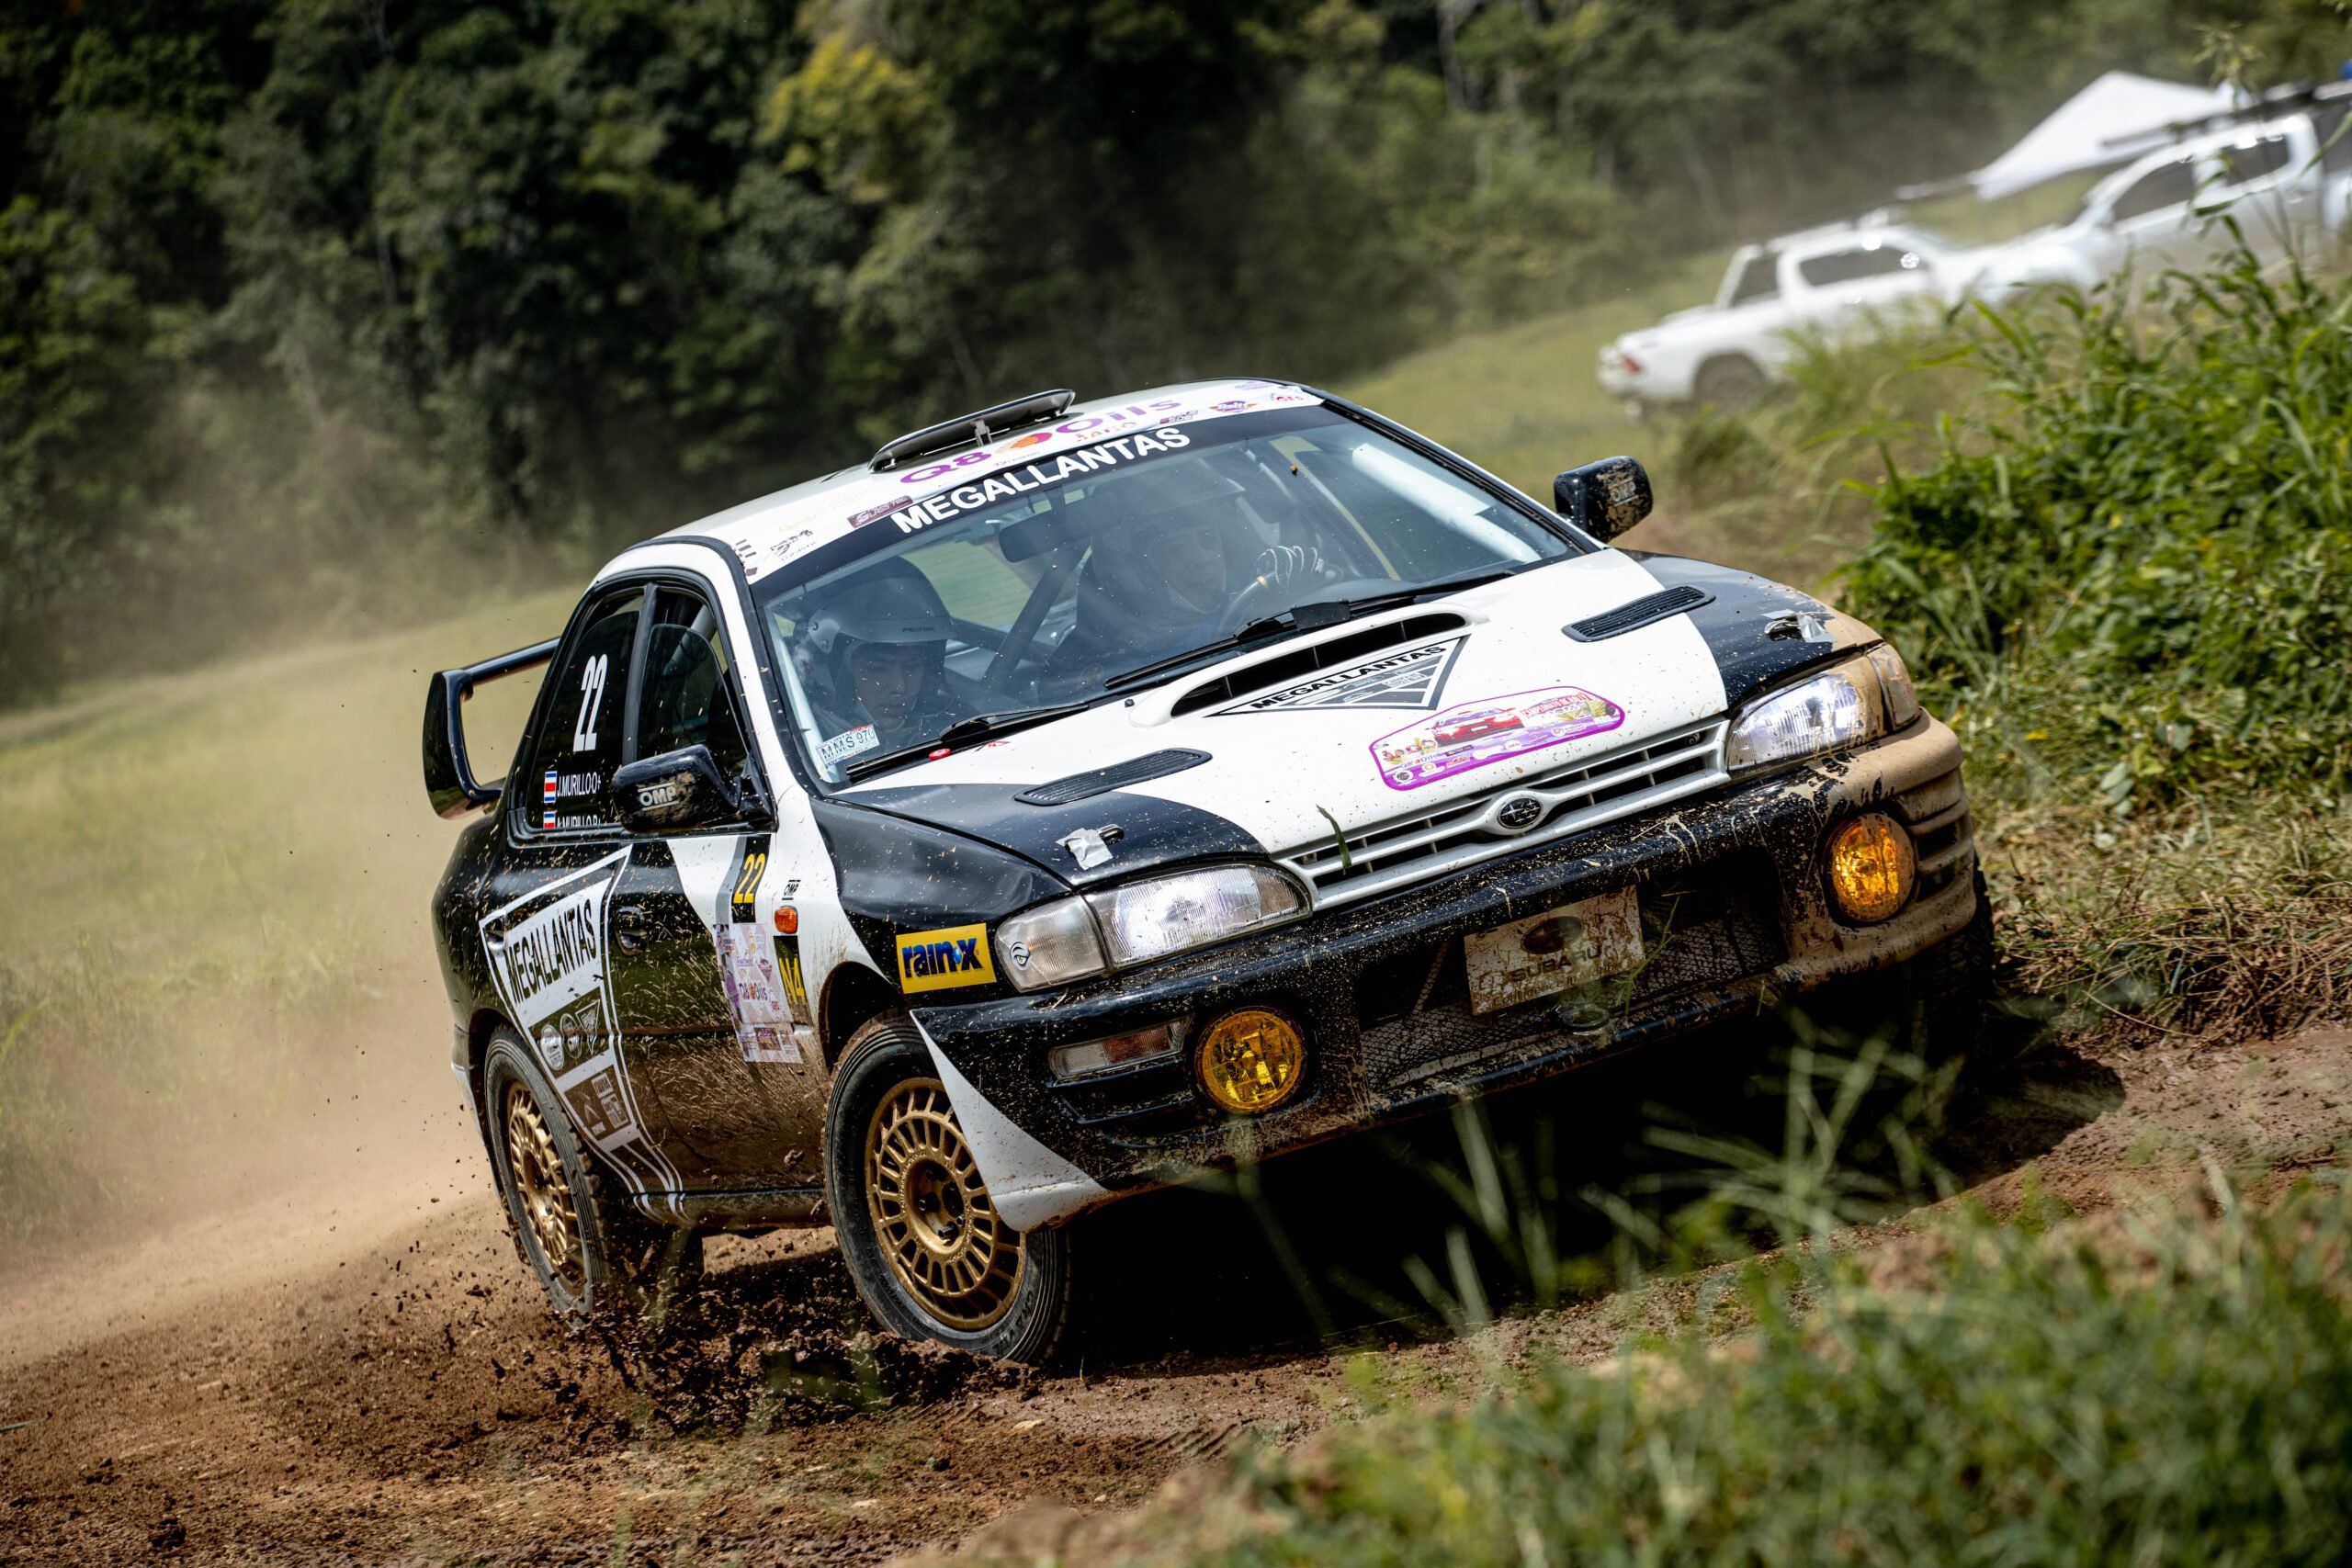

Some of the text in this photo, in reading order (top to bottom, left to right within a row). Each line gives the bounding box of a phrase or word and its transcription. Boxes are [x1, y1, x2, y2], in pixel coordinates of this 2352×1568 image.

[899, 451, 991, 483] Q8
[1057, 400, 1182, 434] Oils
[890, 427, 1191, 534] MEGALLANTAS
[572, 653, 608, 752] 22
[1250, 646, 1447, 709] MEGALLANTAS
[821, 736, 855, 759] MMS
[639, 785, 677, 807] OMP
[732, 853, 766, 904] 22
[503, 898, 597, 1008] MEGALLANTAS
[1511, 943, 1601, 982] SUBARU
